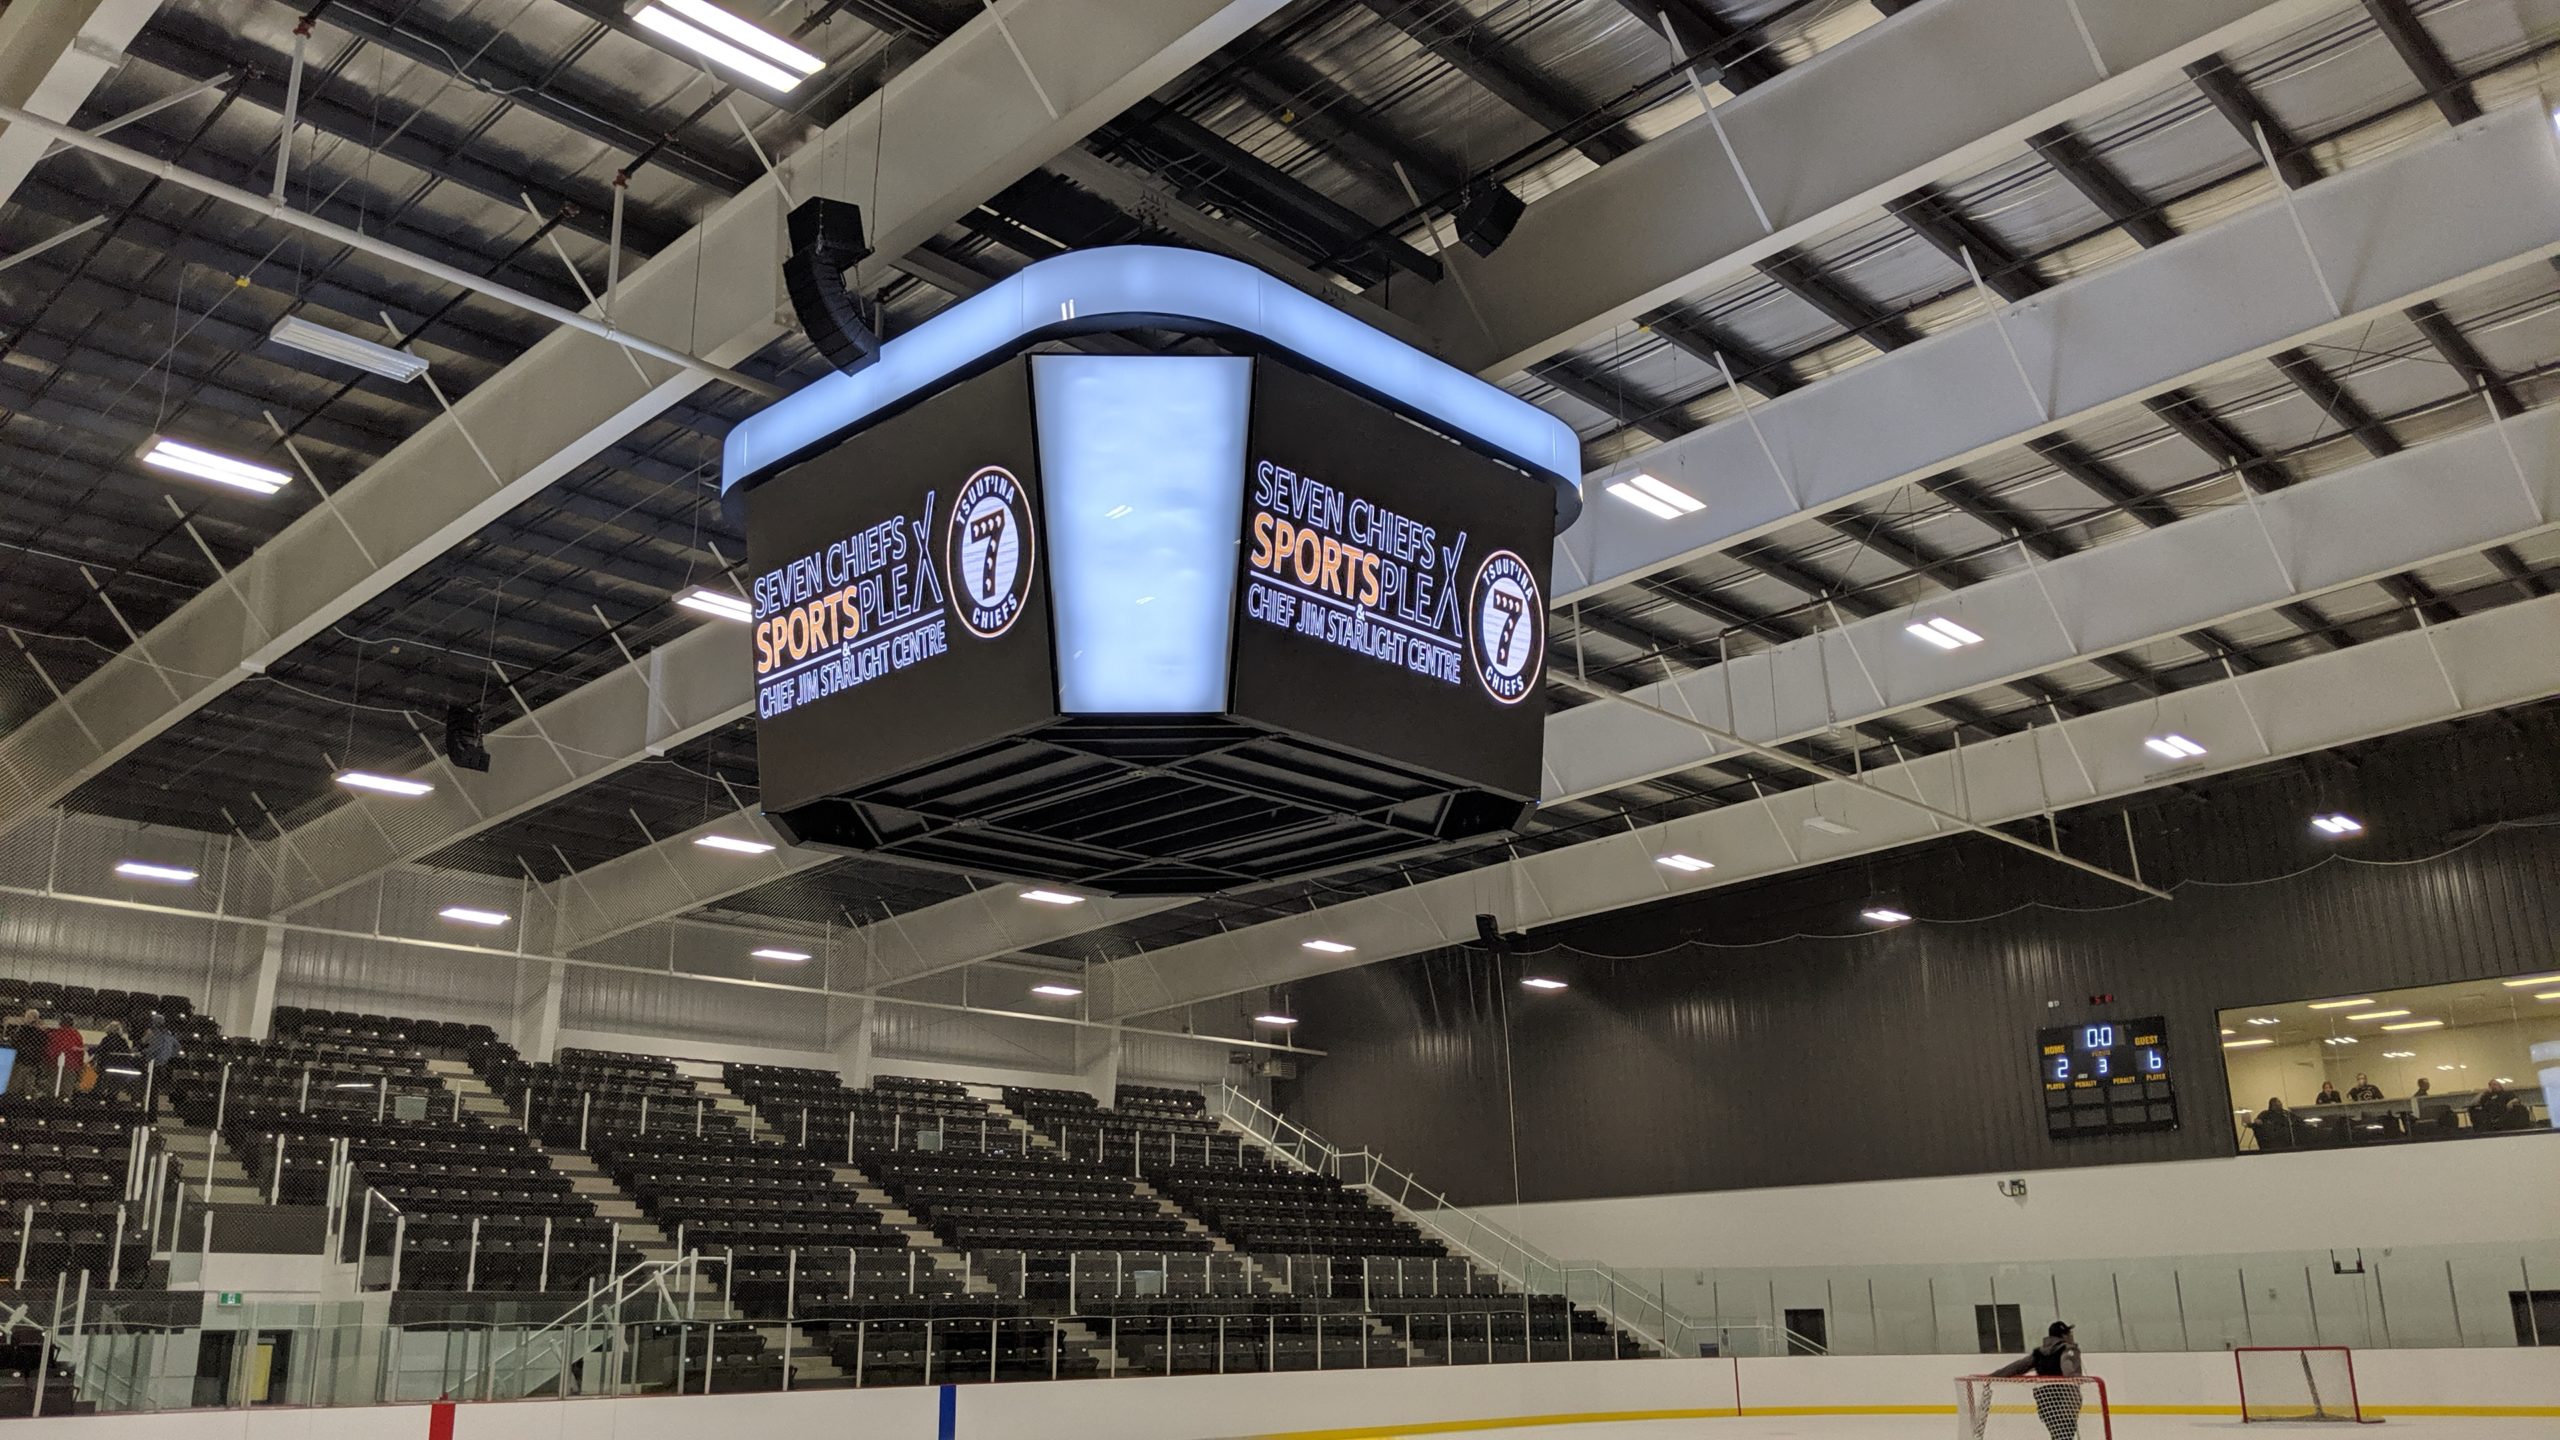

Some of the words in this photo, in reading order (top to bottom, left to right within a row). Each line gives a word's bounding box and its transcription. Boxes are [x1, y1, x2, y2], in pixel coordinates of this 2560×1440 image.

[955, 474, 1015, 524] TSUUT'INA
[1255, 460, 1344, 534] SEVEN
[1349, 499, 1436, 569] CHIEFS
[754, 552, 822, 619] SEVEN
[826, 515, 907, 587] CHIEFS
[969, 507, 1006, 601] 7
[1482, 561, 1533, 601] TSUUT'INA
[972, 592, 1018, 629] CHIEFS
[1355, 603, 1366, 620] &
[1493, 587, 1523, 667] 7
[842, 640, 851, 657] &
[1248, 583, 1296, 628] CHIEF
[1296, 600, 1325, 639] JIM
[1326, 610, 1407, 666] STARLIGHT
[1407, 638, 1462, 684] CENTRE
[759, 678, 795, 720] CHIEF
[796, 668, 820, 706] JIM
[820, 641, 890, 697] STARLIGHT
[892, 620, 948, 670] CENTRE
[1484, 668, 1525, 696] CHIEFS
[2135, 1035, 2158, 1046] GUEST
[2058, 1058, 2069, 1078] 2
[2075, 1080, 2097, 1088] PENALTY
[2099, 1058, 2108, 1073] 3
[2113, 1076, 2136, 1084] PENALTY
